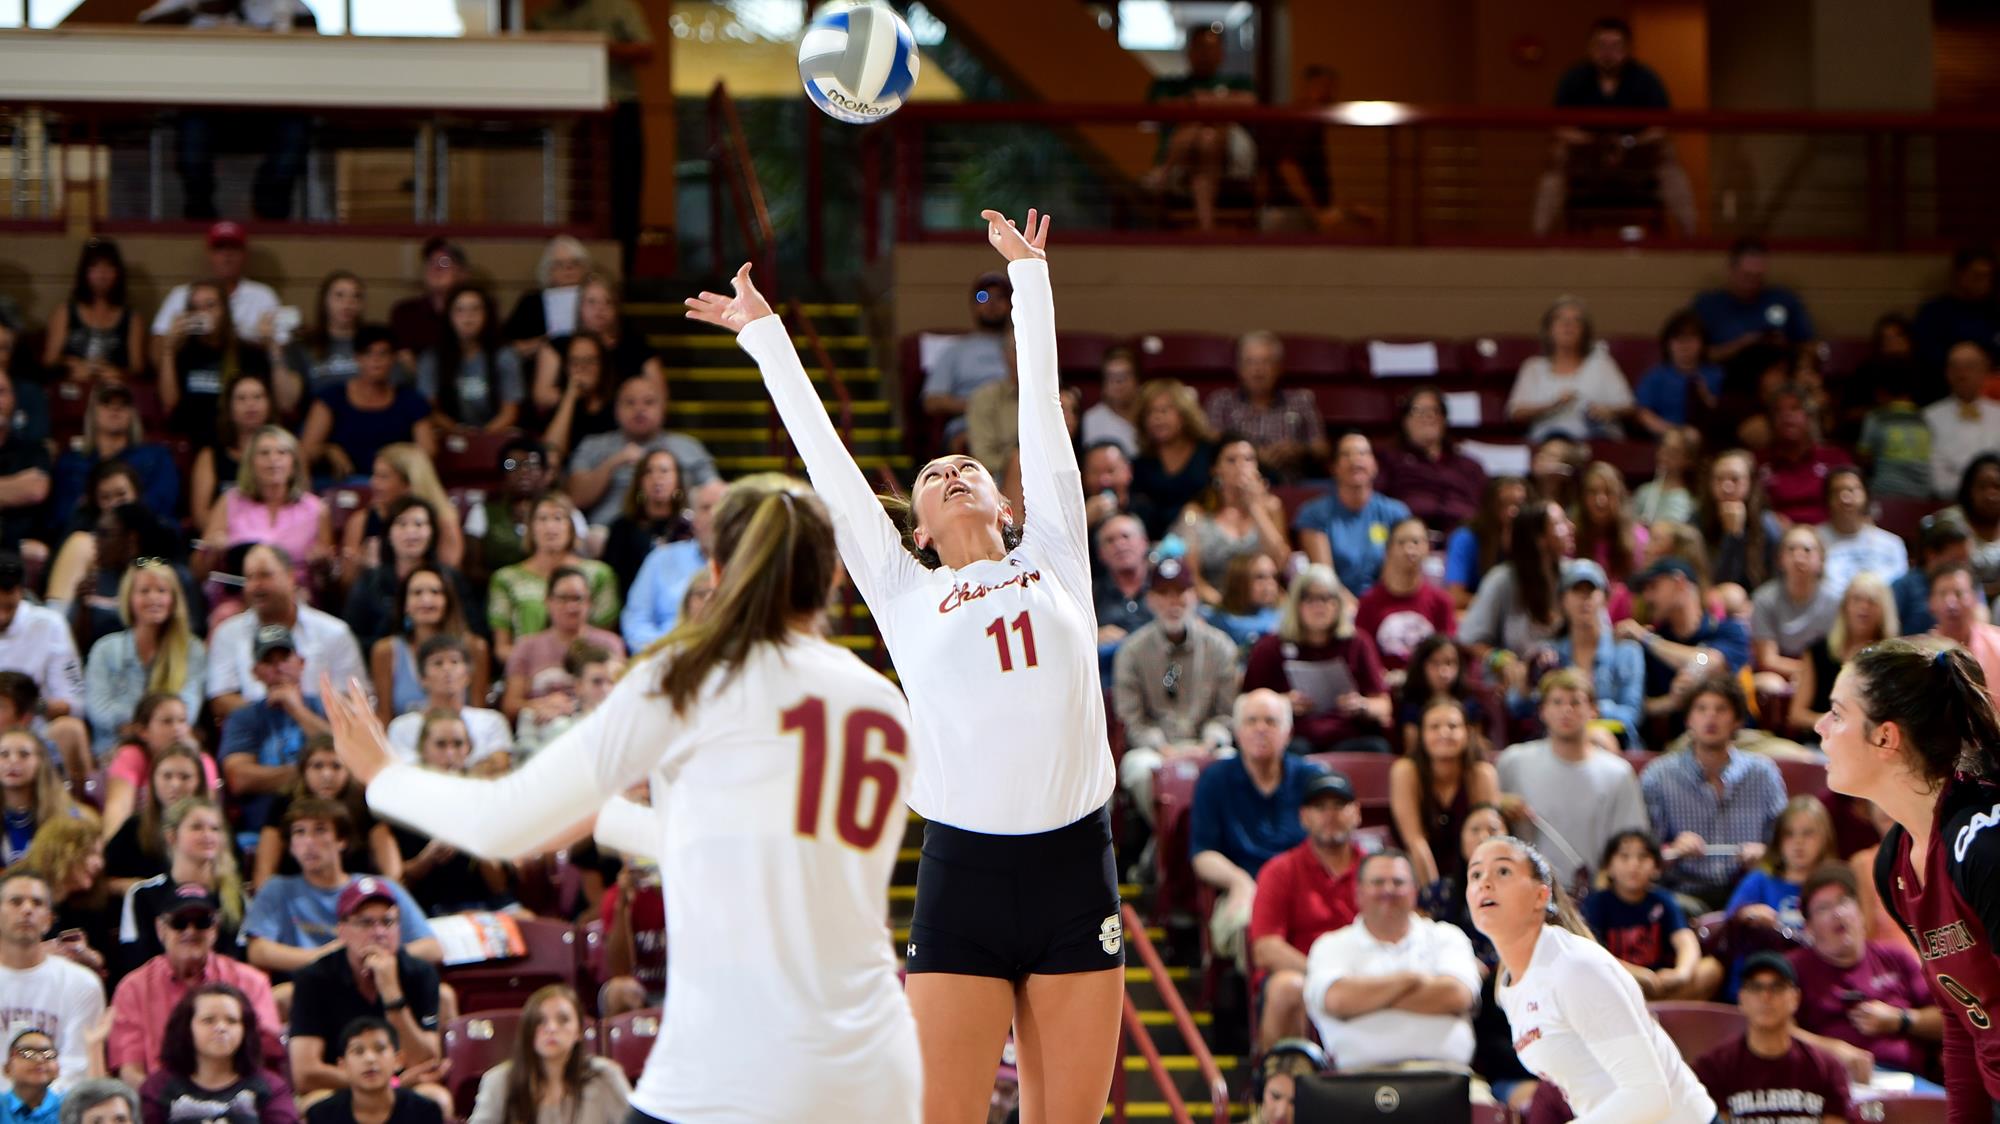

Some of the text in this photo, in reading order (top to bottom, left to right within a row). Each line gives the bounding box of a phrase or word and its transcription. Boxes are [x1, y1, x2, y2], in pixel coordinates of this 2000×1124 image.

[826, 88, 889, 116] molten
[985, 609, 1039, 673] 11
[779, 693, 909, 853] 16
[1954, 803, 2000, 863] CA
[1908, 919, 1977, 962] LESTON
[1936, 973, 1991, 1029] 9
